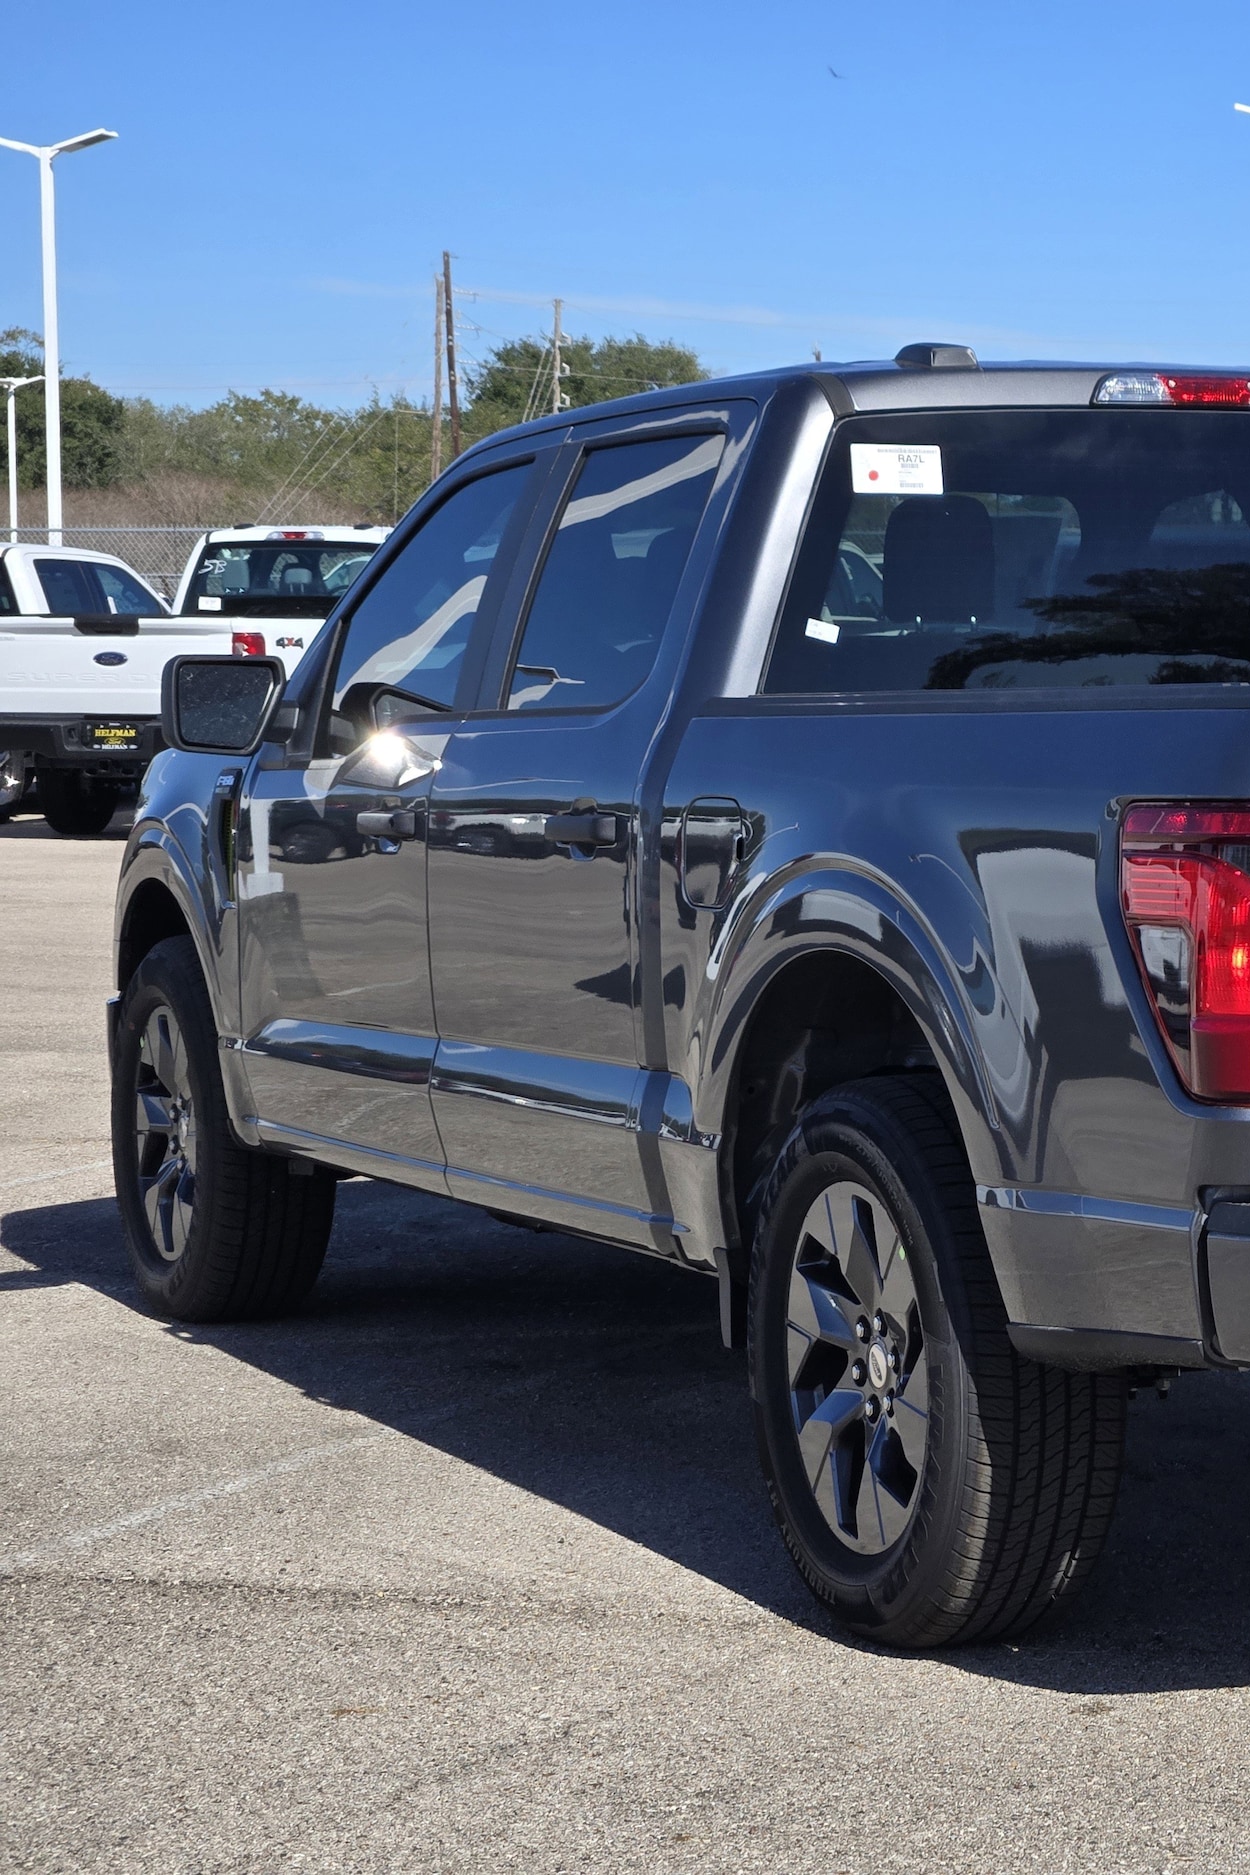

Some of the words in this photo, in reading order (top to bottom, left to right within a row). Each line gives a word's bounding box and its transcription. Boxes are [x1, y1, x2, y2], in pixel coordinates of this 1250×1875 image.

[897, 454, 925, 463] RA7L
[8, 672, 120, 683] SUPER
[94, 729, 137, 737] HELFMAN
